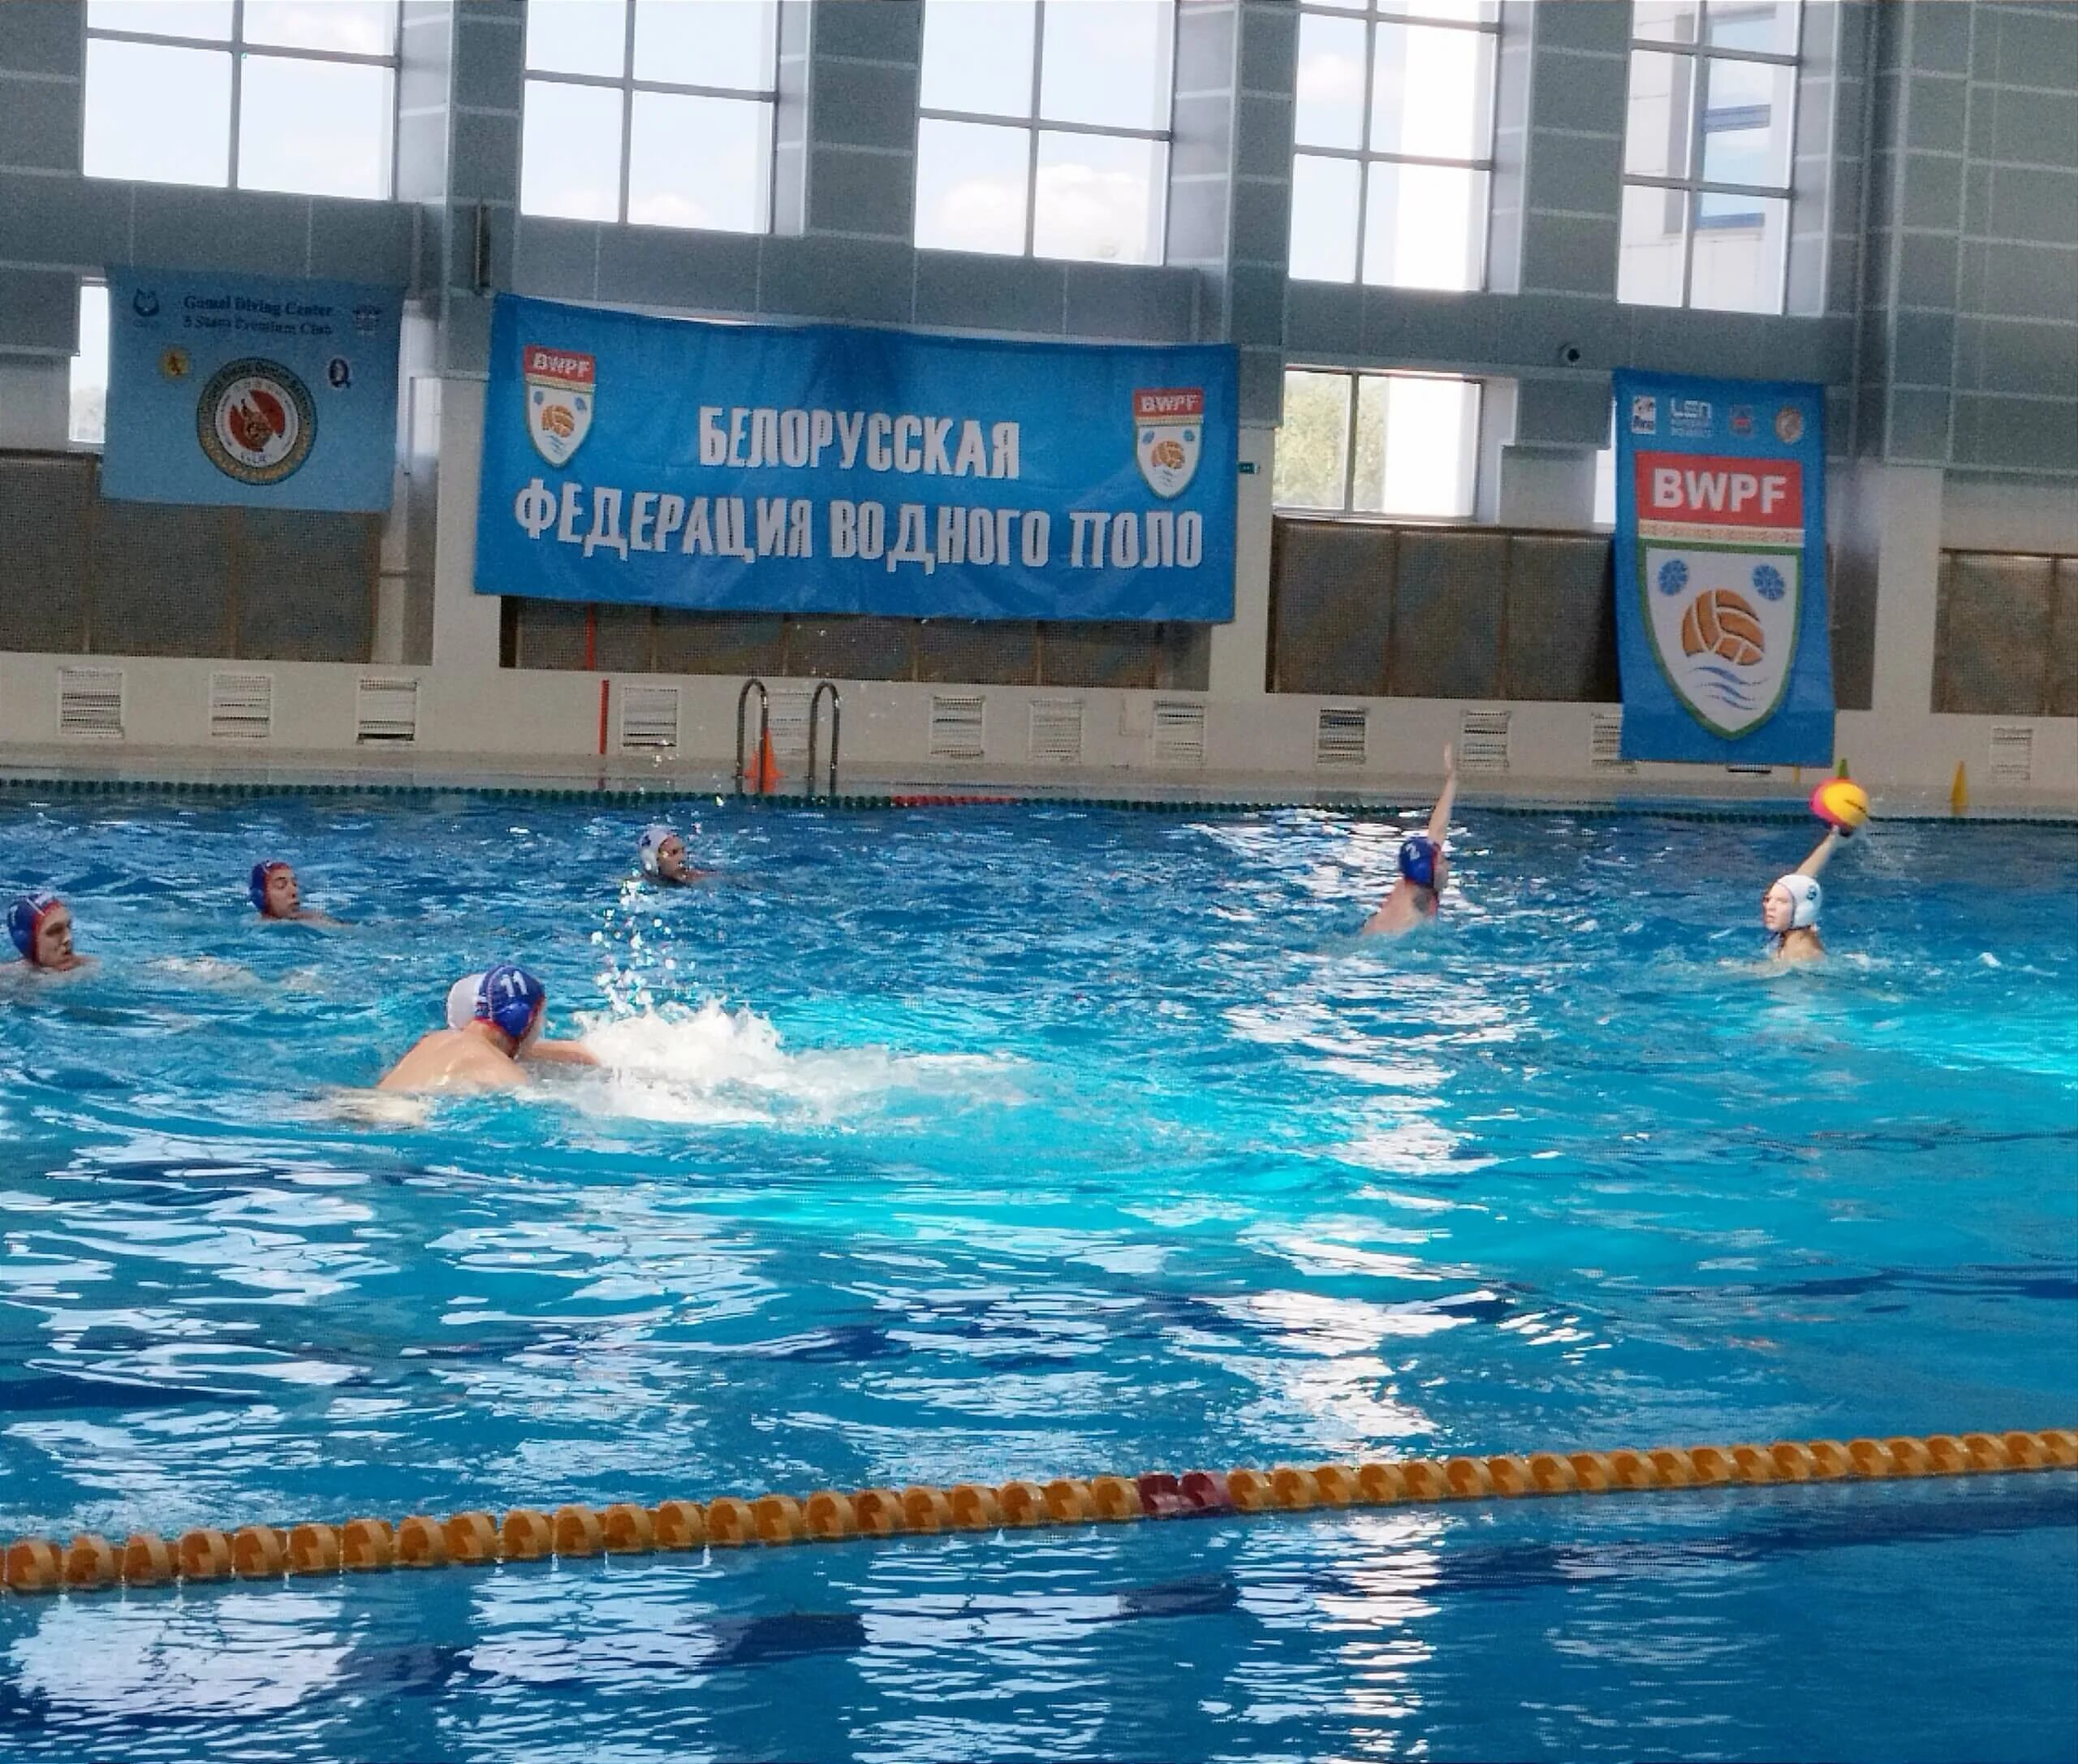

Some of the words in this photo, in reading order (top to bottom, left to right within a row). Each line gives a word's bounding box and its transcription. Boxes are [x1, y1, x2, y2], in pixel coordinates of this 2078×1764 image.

[285, 301, 334, 317] Center
[532, 351, 592, 377] BWPF
[1140, 394, 1200, 413] BWPF
[698, 406, 1020, 480] БЕЛОРУССКАЯ
[1653, 467, 1788, 514] BWPF
[514, 478, 813, 563] ФЕДЕРАЦИЯ
[829, 499, 1050, 576] ВОДНОГО
[1069, 510, 1203, 569] ПОЛО
[500, 970, 528, 998] 11
